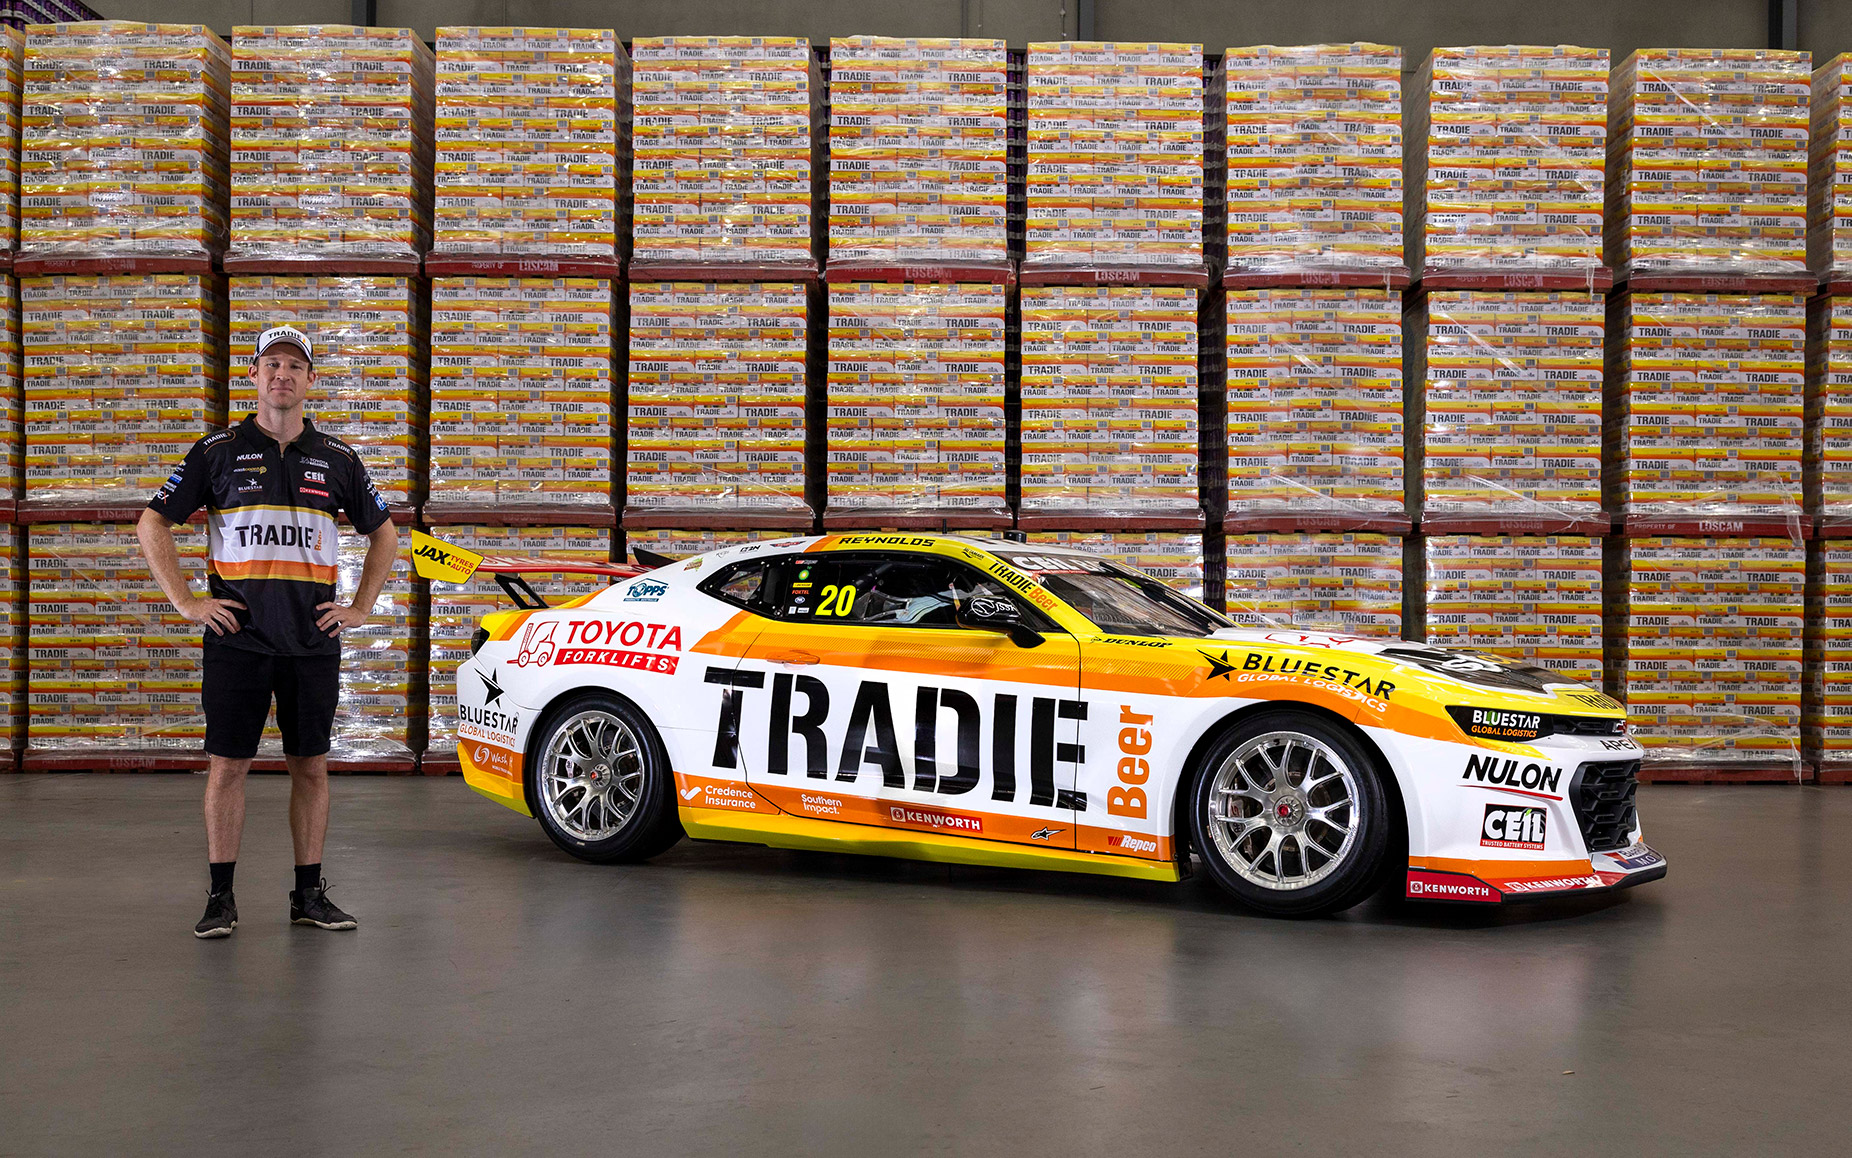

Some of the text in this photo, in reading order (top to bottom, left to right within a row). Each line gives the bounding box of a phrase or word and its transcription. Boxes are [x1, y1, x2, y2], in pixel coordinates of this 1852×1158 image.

[237, 61, 272, 69] TRADIE
[838, 72, 871, 80] TRADIE
[142, 106, 176, 114] TRADIE
[838, 116, 871, 125] TRADIE
[1547, 126, 1580, 135] TRADIE
[1640, 127, 1673, 135] TRADIE
[141, 151, 175, 159] TRADIE
[236, 152, 271, 160] TRADIE
[640, 161, 673, 169] TRADIE
[1638, 172, 1671, 180] TRADIE
[27, 198, 61, 206] TRADIE
[236, 198, 271, 206] TRADIE
[555, 199, 588, 208] TRADIE
[640, 205, 673, 213] TRADIE
[836, 205, 869, 214] TRADIE
[1341, 212, 1374, 220] TRADIE
[1544, 215, 1577, 223] TRADIE
[1637, 216, 1670, 224] TRADIE
[1095, 271, 1140, 281] LOSCAM
[1138, 322, 1171, 330] TRADIE
[1233, 325, 1266, 333] TRADIE
[1546, 327, 1579, 335] TRADIE
[550, 358, 583, 367] TRADIE
[635, 362, 668, 371] TRADIE
[835, 363, 868, 371] TRADIE
[945, 363, 978, 372] TRADIE
[1139, 366, 1172, 375] TRADIE
[1234, 369, 1267, 377] TRADIE
[1433, 370, 1466, 378] TRADIE
[1544, 370, 1577, 379] TRADIE
[1637, 372, 1670, 380] TRADIE
[348, 402, 381, 410] TRADIE
[550, 403, 583, 412] TRADIE
[634, 407, 667, 416] TRADIE
[1139, 410, 1172, 419] TRADIE
[1636, 416, 1669, 424] TRADIE
[203, 433, 227, 446] TRADIE
[33, 446, 66, 454] TRADIE
[328, 440, 350, 454] TRADIE
[550, 448, 583, 456] TRADIE
[633, 452, 666, 460] TRADIE
[834, 452, 867, 461] TRADIE
[1235, 458, 1268, 466] TRADIE
[1636, 461, 1669, 469] TRADIE
[304, 471, 325, 482] CEIL
[1699, 522, 1744, 532] LOSCAM
[235, 524, 313, 549] TRADIE
[838, 536, 936, 547] REYNOLDS
[414, 545, 450, 565] JAX
[450, 555, 474, 569] TYRES
[450, 563, 471, 575] AUTO
[1543, 571, 1576, 579] TRADIE
[1638, 573, 1671, 581] TRADIE
[988, 560, 1036, 594] TRADIE
[1028, 587, 1058, 611] Beer
[815, 585, 856, 616] 20
[34, 604, 69, 612] TRADIE
[437, 606, 471, 614] TRADIE
[1543, 615, 1576, 624] TRADIE
[1636, 617, 1669, 625] TRADIE
[567, 620, 682, 651] TOYOTA
[1103, 638, 1173, 648] DUNLOP
[35, 649, 68, 657] TRADIE
[563, 651, 669, 671] FORKLIFTS
[1544, 660, 1577, 668] TRADIE
[1634, 661, 1667, 669] TRADIE
[1242, 653, 1396, 700] BLUESTAR
[1237, 673, 1388, 712] GLOBAL LOGISTICS
[35, 694, 68, 702] TRADIE
[1633, 706, 1666, 714] TRADIE
[460, 704, 518, 734] BLUESTAR
[1473, 710, 1540, 729] BLUESTAR
[460, 724, 515, 747] GLOBAL LOGISTICS
[1471, 725, 1537, 738] GLOBAL LOGISTICS
[704, 666, 1088, 812] TRADIE
[1107, 704, 1154, 820] Beer
[1462, 754, 1562, 792] NULON
[705, 785, 753, 798] Credence
[705, 796, 756, 809] Insurance
[801, 794, 842, 807] Southern
[907, 812, 981, 832] KENWORTH
[1120, 834, 1157, 853] Repco
[1425, 884, 1489, 896] KENWORTH
